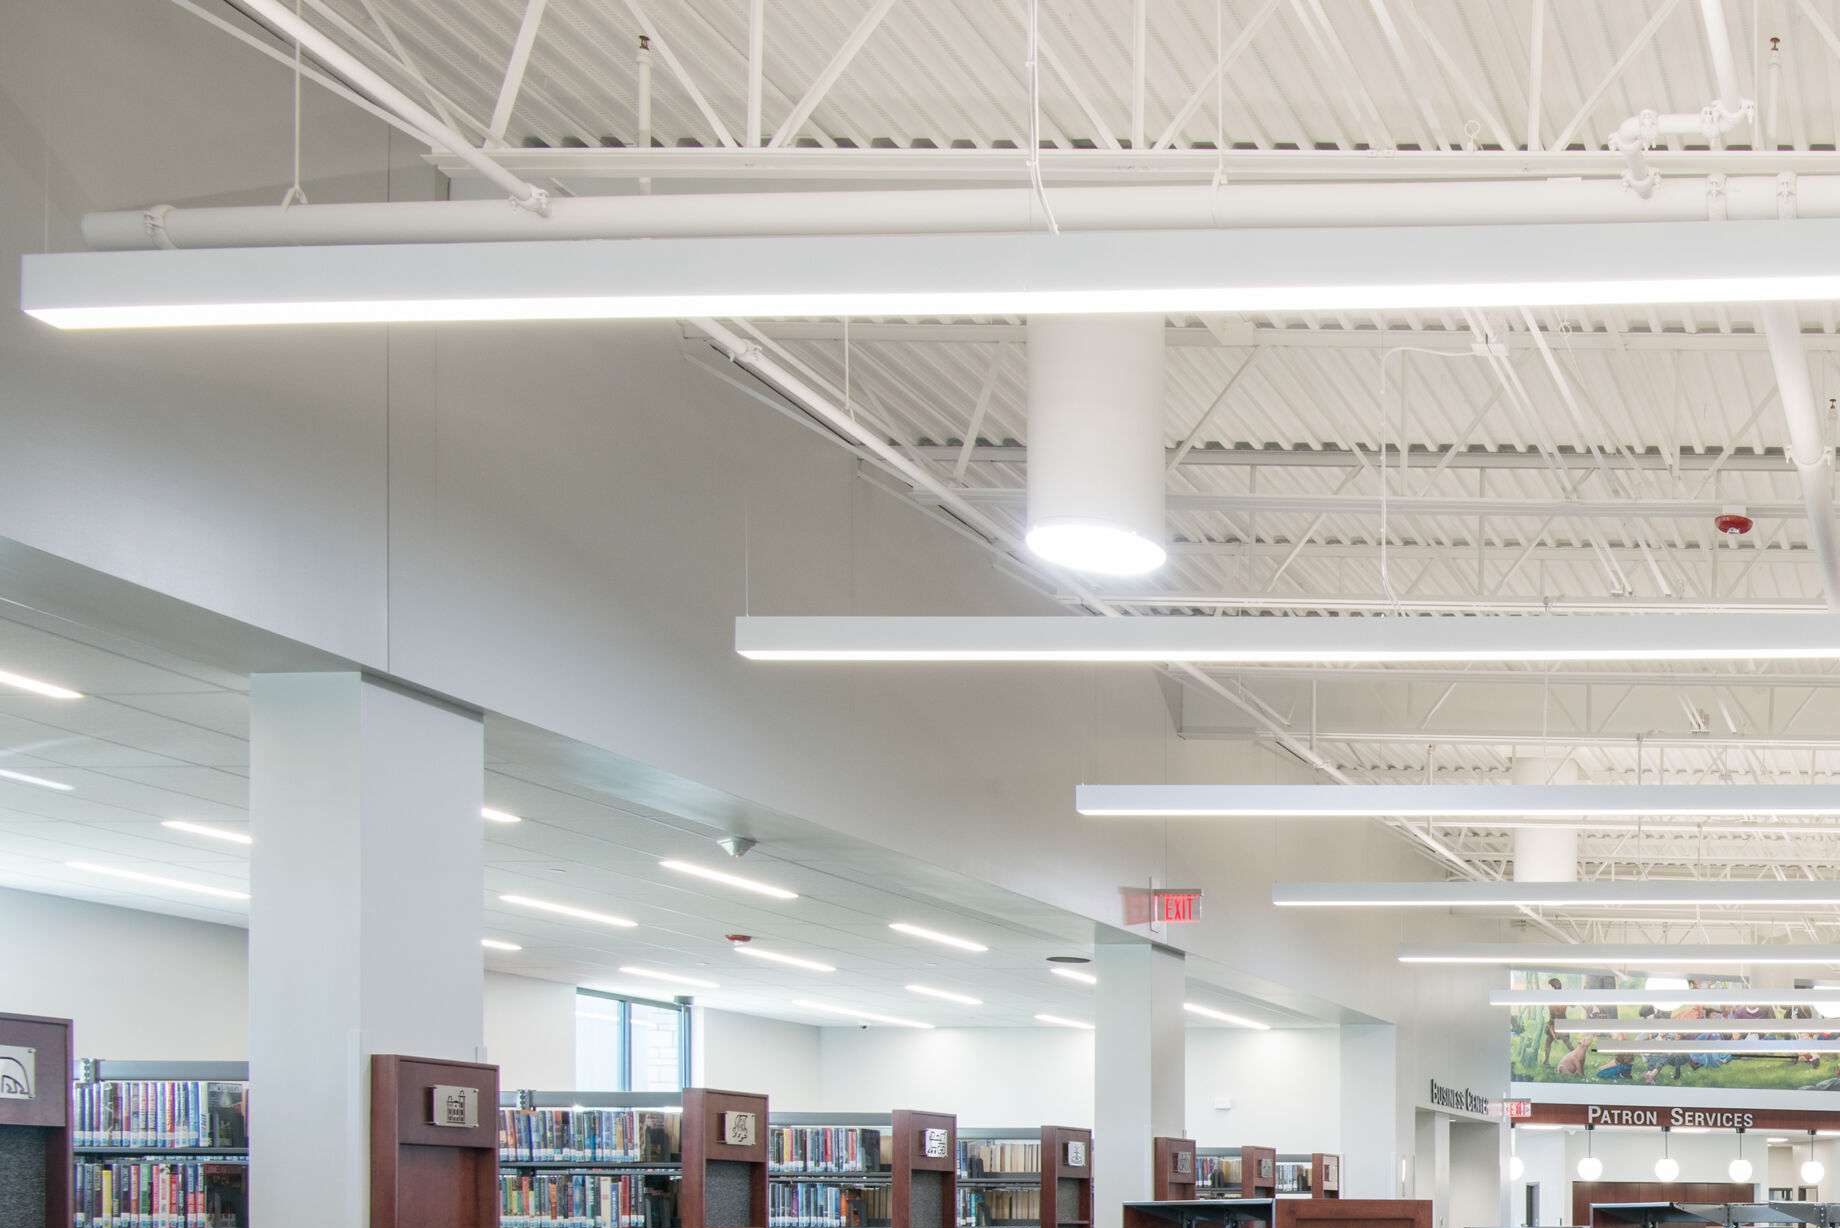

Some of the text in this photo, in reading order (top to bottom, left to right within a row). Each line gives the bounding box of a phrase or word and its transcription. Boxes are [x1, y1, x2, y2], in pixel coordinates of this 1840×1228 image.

[1165, 898, 1194, 920] EXIT
[1431, 1079, 1464, 1111] BUSINESS
[1510, 1101, 1527, 1117] EXIT
[1588, 1105, 1753, 1127] PATRON SERVICES
